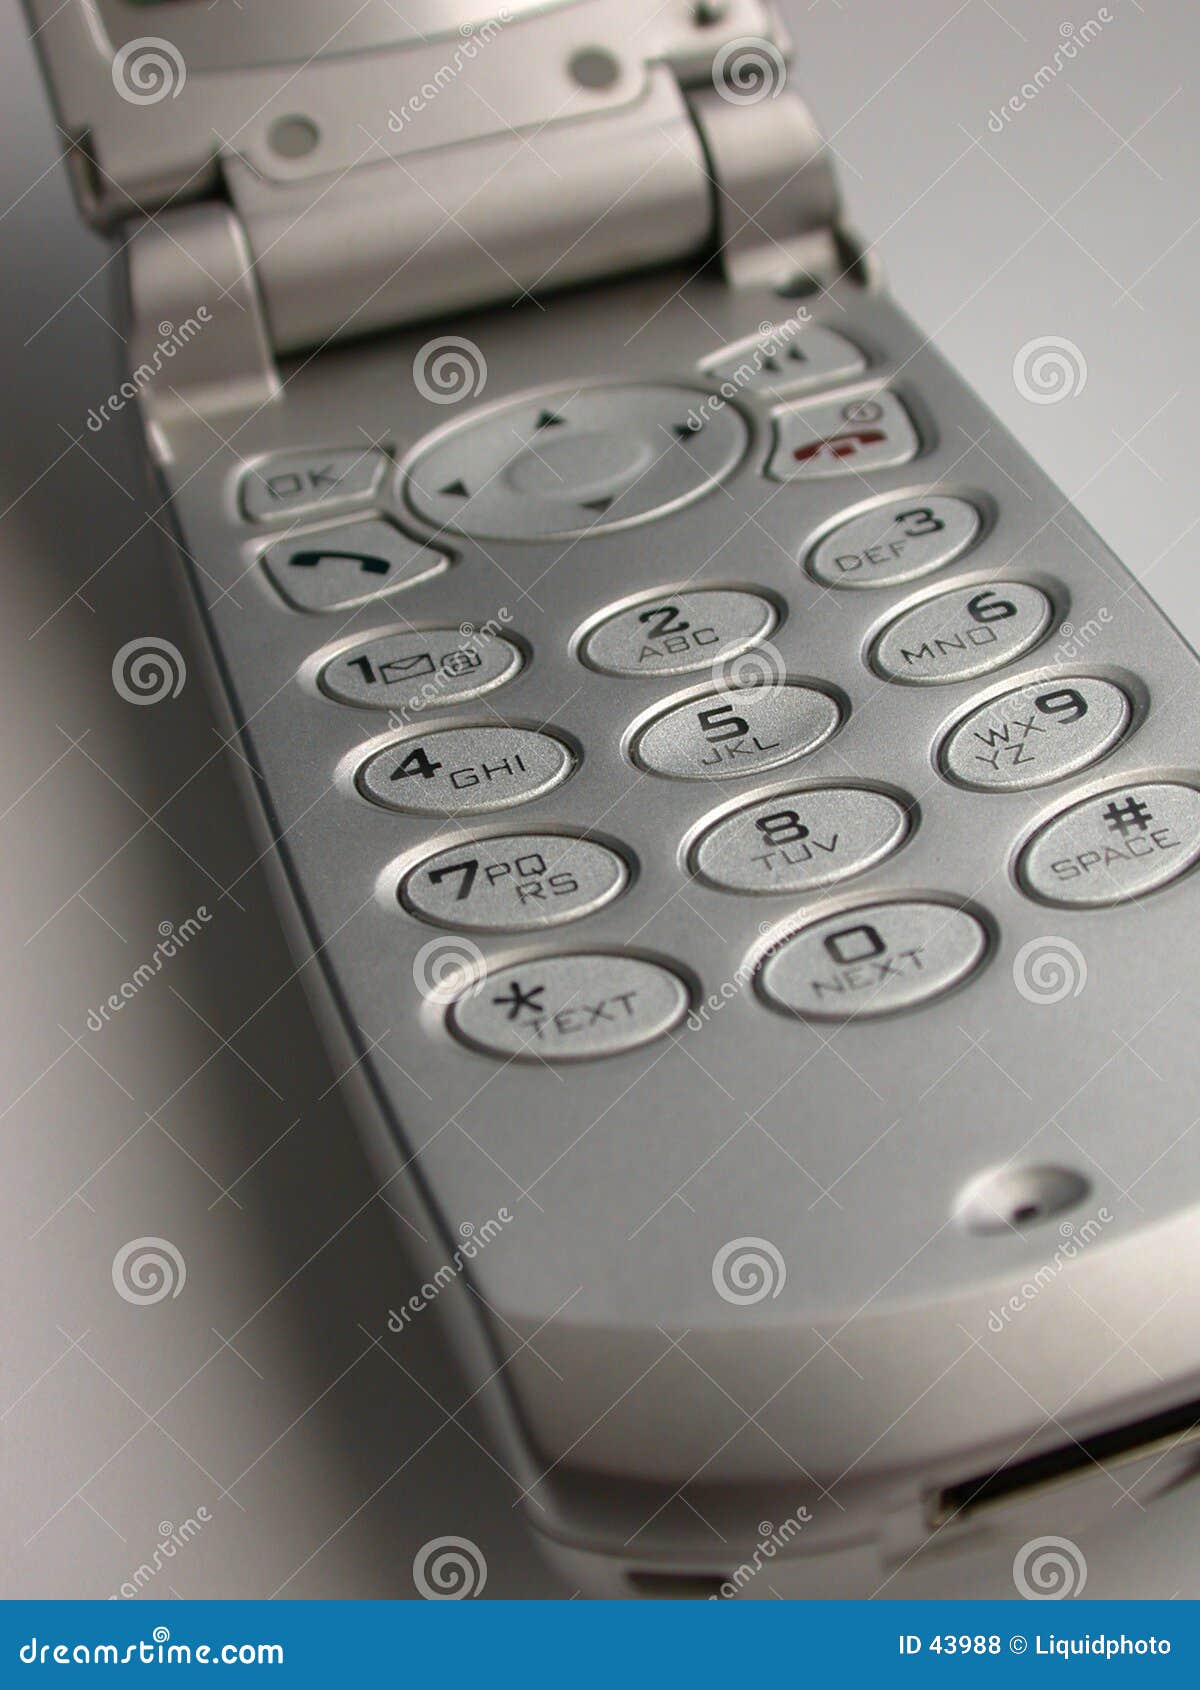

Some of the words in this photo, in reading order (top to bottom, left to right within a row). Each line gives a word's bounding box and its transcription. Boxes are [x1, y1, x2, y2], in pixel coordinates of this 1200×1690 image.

[265, 465, 343, 499] OK
[895, 507, 945, 538] 3
[834, 540, 908, 572] DEF
[638, 605, 690, 640] 2
[967, 591, 1018, 624] 6
[638, 627, 719, 663] ABC
[900, 624, 998, 665] MNO
[347, 655, 377, 684] 1
[697, 704, 750, 743] 5
[1034, 687, 1089, 724] 9
[974, 715, 1048, 749] WX
[389, 747, 442, 781] 4
[450, 754, 526, 790] GHI
[700, 736, 780, 766] JKL
[974, 742, 1036, 771] YZ
[755, 810, 809, 846] 8
[1102, 796, 1154, 836] #
[750, 833, 840, 871] TUV
[1051, 828, 1182, 882] SPACE
[428, 859, 479, 900] 7
[484, 853, 547, 886] PQ
[515, 872, 579, 904] RS
[810, 947, 925, 999] NEXT
[522, 991, 637, 1039] TEXT
